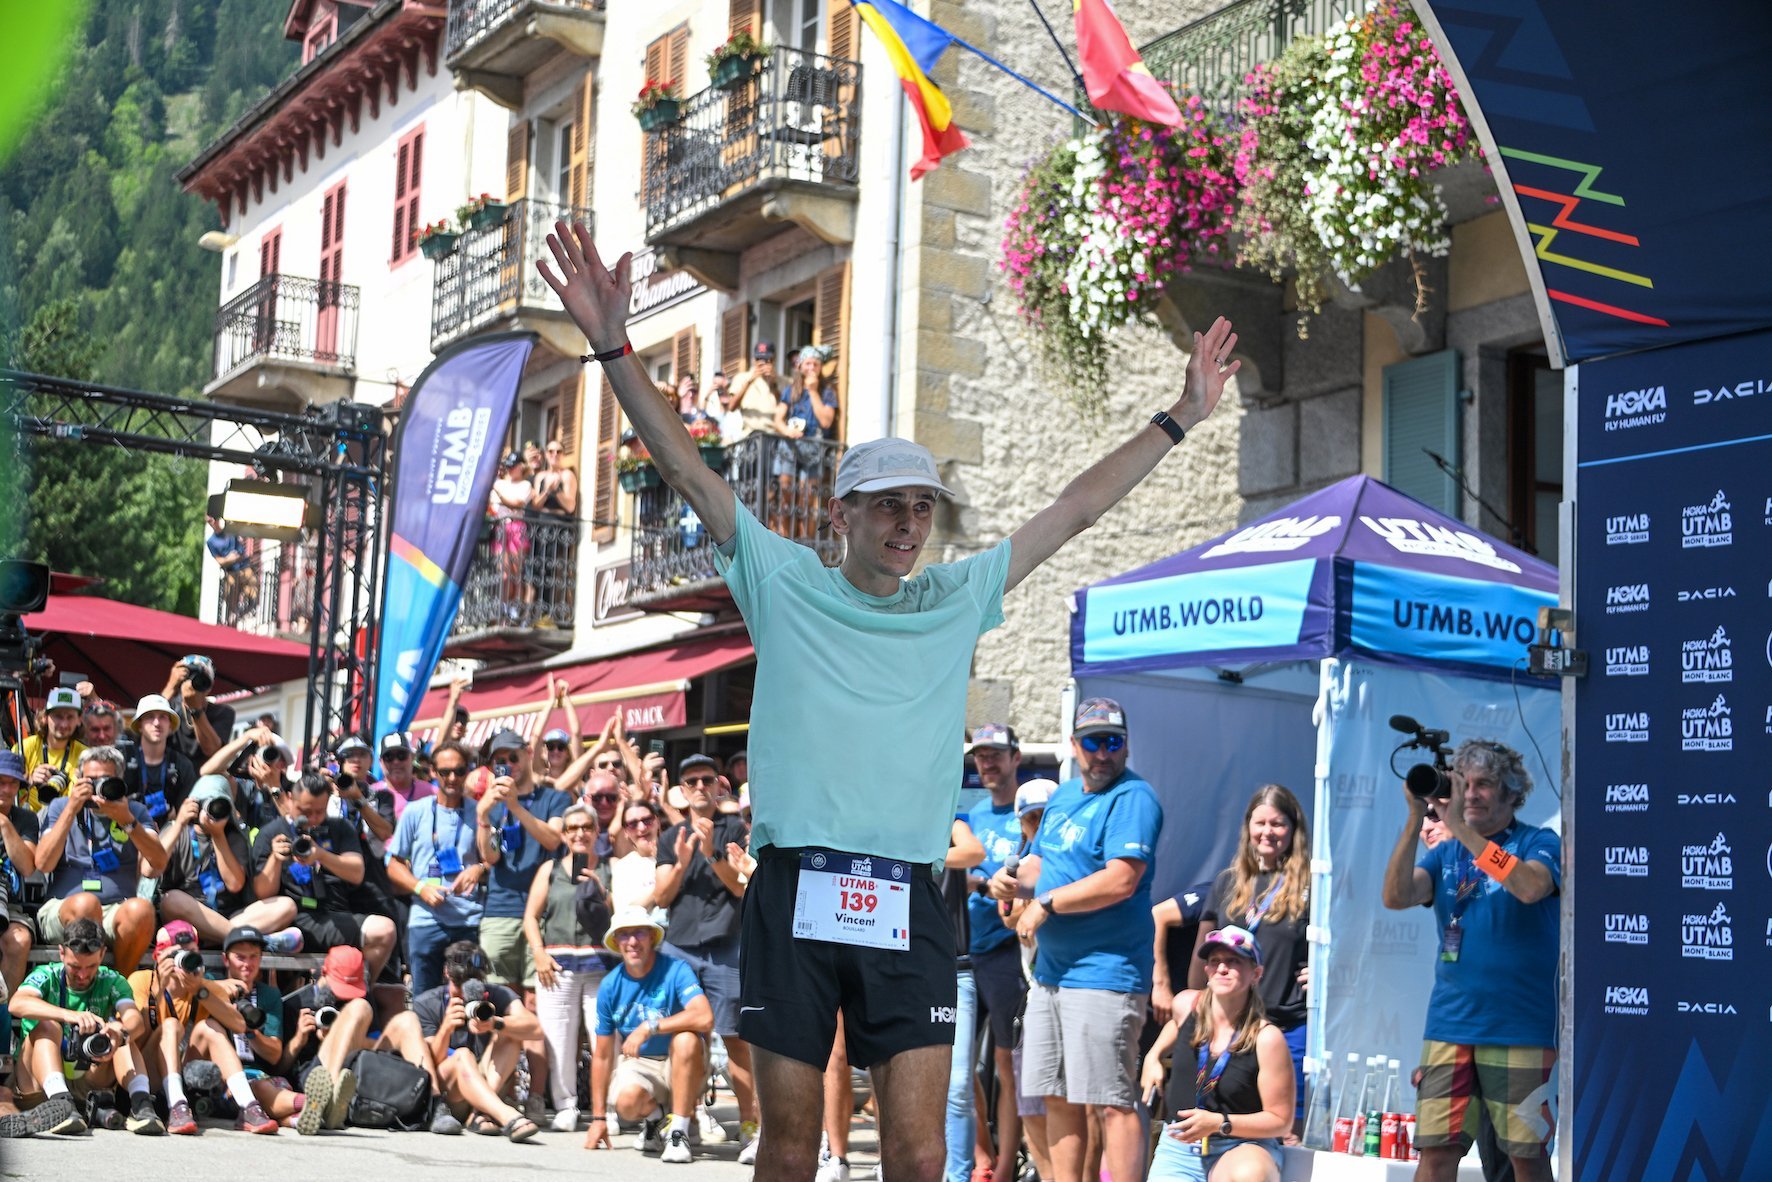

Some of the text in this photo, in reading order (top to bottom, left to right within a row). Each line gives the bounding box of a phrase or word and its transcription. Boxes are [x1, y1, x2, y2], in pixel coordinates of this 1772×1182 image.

[630, 252, 657, 283] HO
[1605, 385, 1667, 418] HOKA
[1605, 412, 1666, 432] FLY HUMAN FLY
[431, 407, 473, 504] UTMB
[878, 453, 931, 474] HOKA
[1682, 504, 1708, 517] HOKA
[1606, 513, 1649, 533] UTMB
[1682, 513, 1732, 535] UTMB
[1359, 515, 1496, 557] UTMB
[1606, 583, 1649, 604] HOKA
[1677, 586, 1736, 602] DACIA
[1114, 596, 1264, 636] UTMB.WORLD
[1394, 599, 1540, 645] UTMB.WO
[1682, 639, 1708, 651] HOKA
[1606, 645, 1649, 665] UTMB
[1682, 649, 1732, 670] UTMB
[626, 705, 665, 727] SNACK
[1606, 712, 1649, 731] UTMB
[1682, 707, 1708, 720] HOKA
[1682, 718, 1732, 738] UTMB
[1605, 784, 1649, 802] HOKA
[1677, 793, 1736, 804] DACIA
[1489, 849, 1504, 864] UT
[1605, 846, 1648, 864] UTMB
[1682, 845, 1708, 856] HOKA
[851, 863, 872, 872] UTMB
[1682, 856, 1732, 876] UTMB
[840, 877, 875, 891] UTMB
[841, 890, 878, 913] 139
[835, 912, 875, 927] Vincent
[1605, 914, 1648, 932] UTMB
[1682, 914, 1708, 926] HOKA
[1682, 926, 1732, 946] UTMB
[1605, 986, 1649, 1005] HOKA
[930, 1006, 957, 1023] HOK
[1677, 1001, 1737, 1014] DACIA
